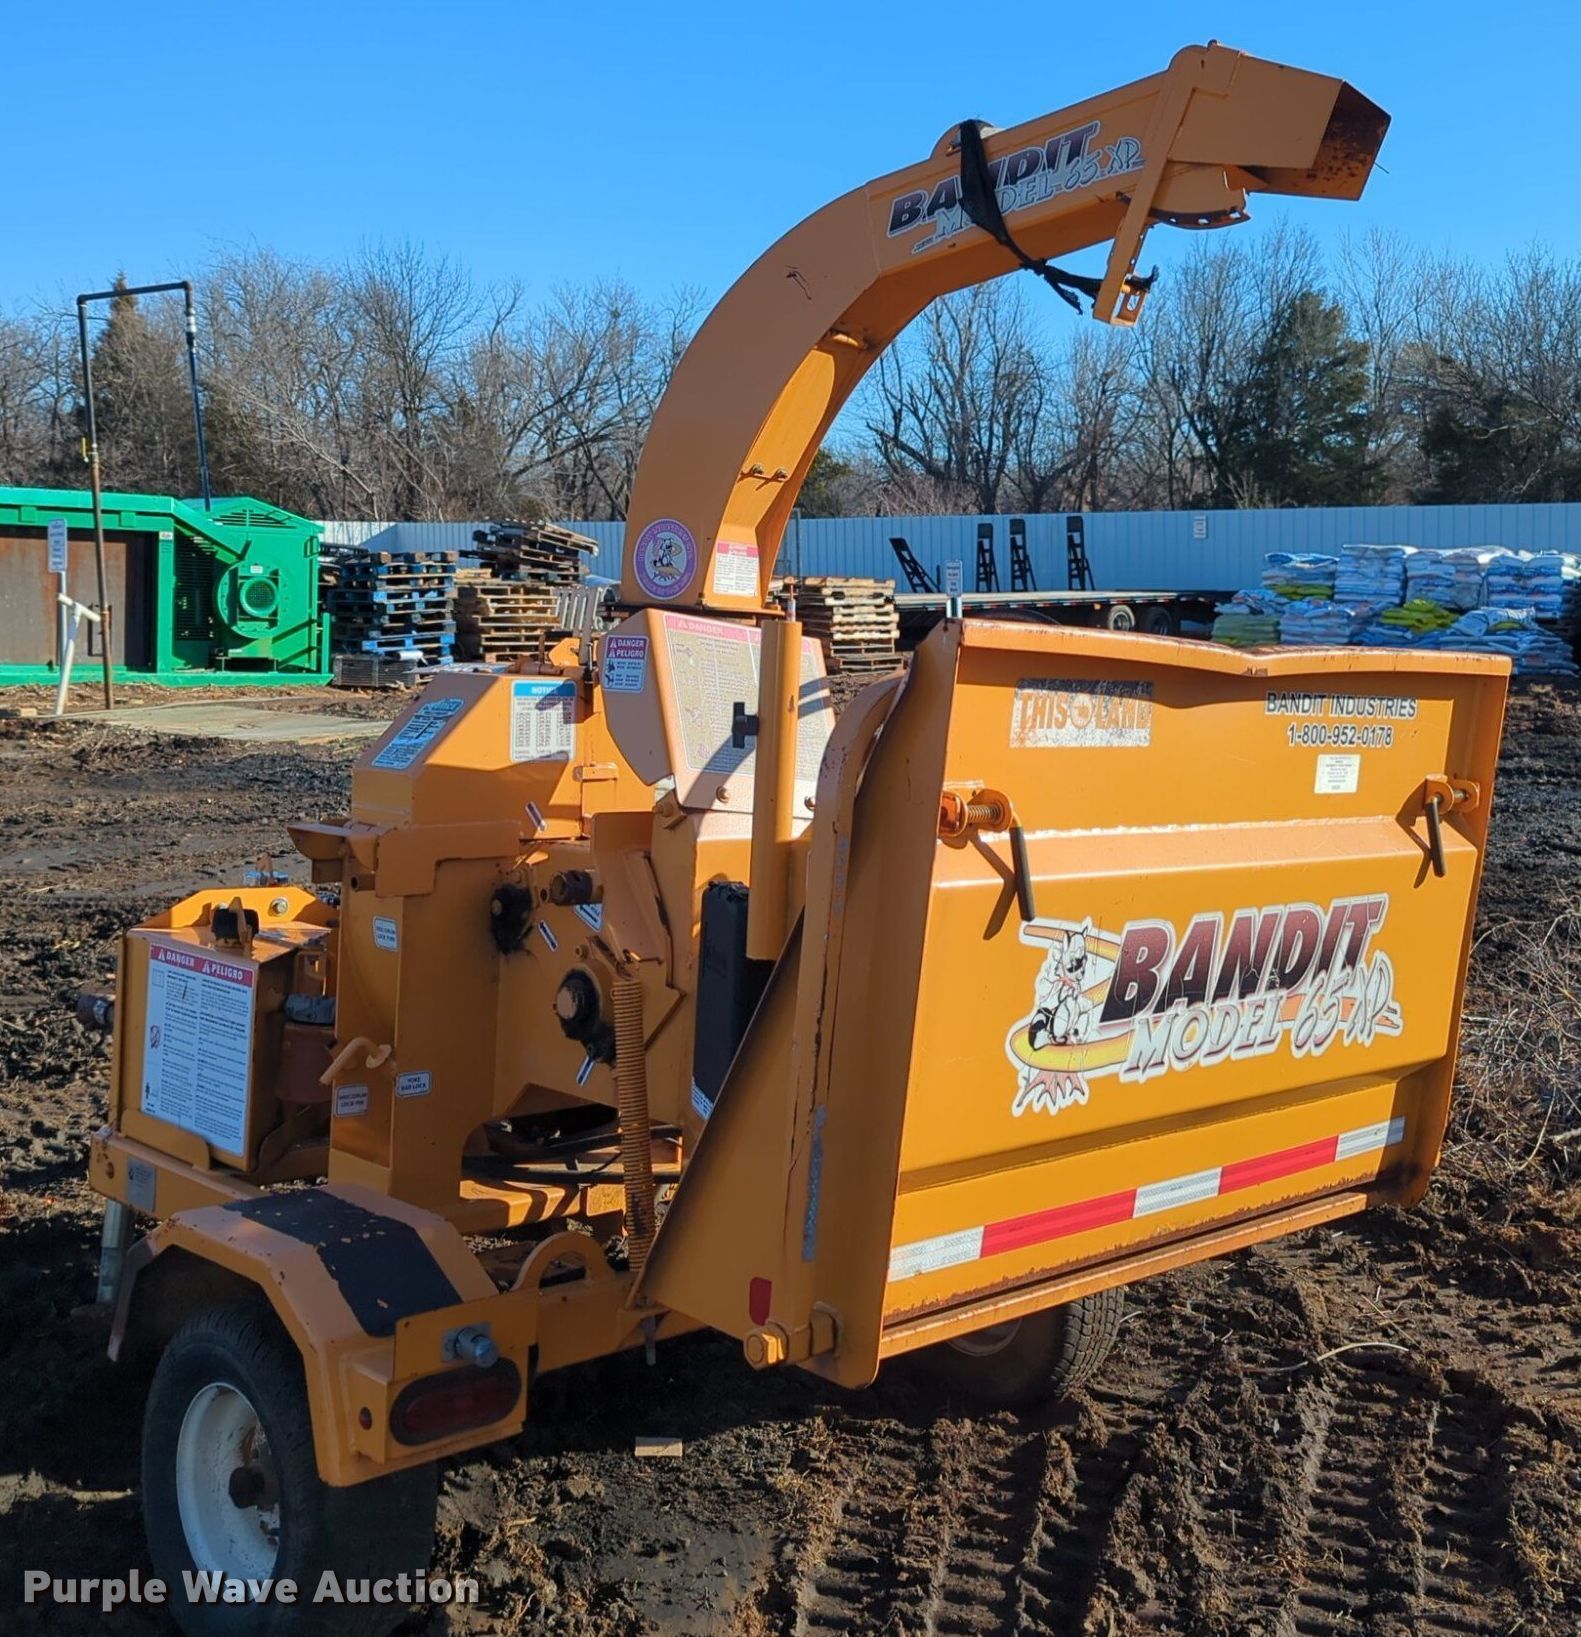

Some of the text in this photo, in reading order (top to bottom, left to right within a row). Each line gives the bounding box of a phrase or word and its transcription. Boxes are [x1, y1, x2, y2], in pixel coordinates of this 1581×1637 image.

[936, 170, 1054, 238] MDEL
[1065, 149, 1101, 190] 65
[1020, 689, 1069, 730] THIS
[1266, 692, 1417, 718] BANDIT INDUSTRIES
[1288, 723, 1393, 747] 1-800-952-0178
[166, 951, 243, 980] DANGER PELIGRO
[1100, 899, 1385, 1025] BANDIT
[1123, 994, 1283, 1075] MODEL
[1295, 970, 1350, 1050] 65
